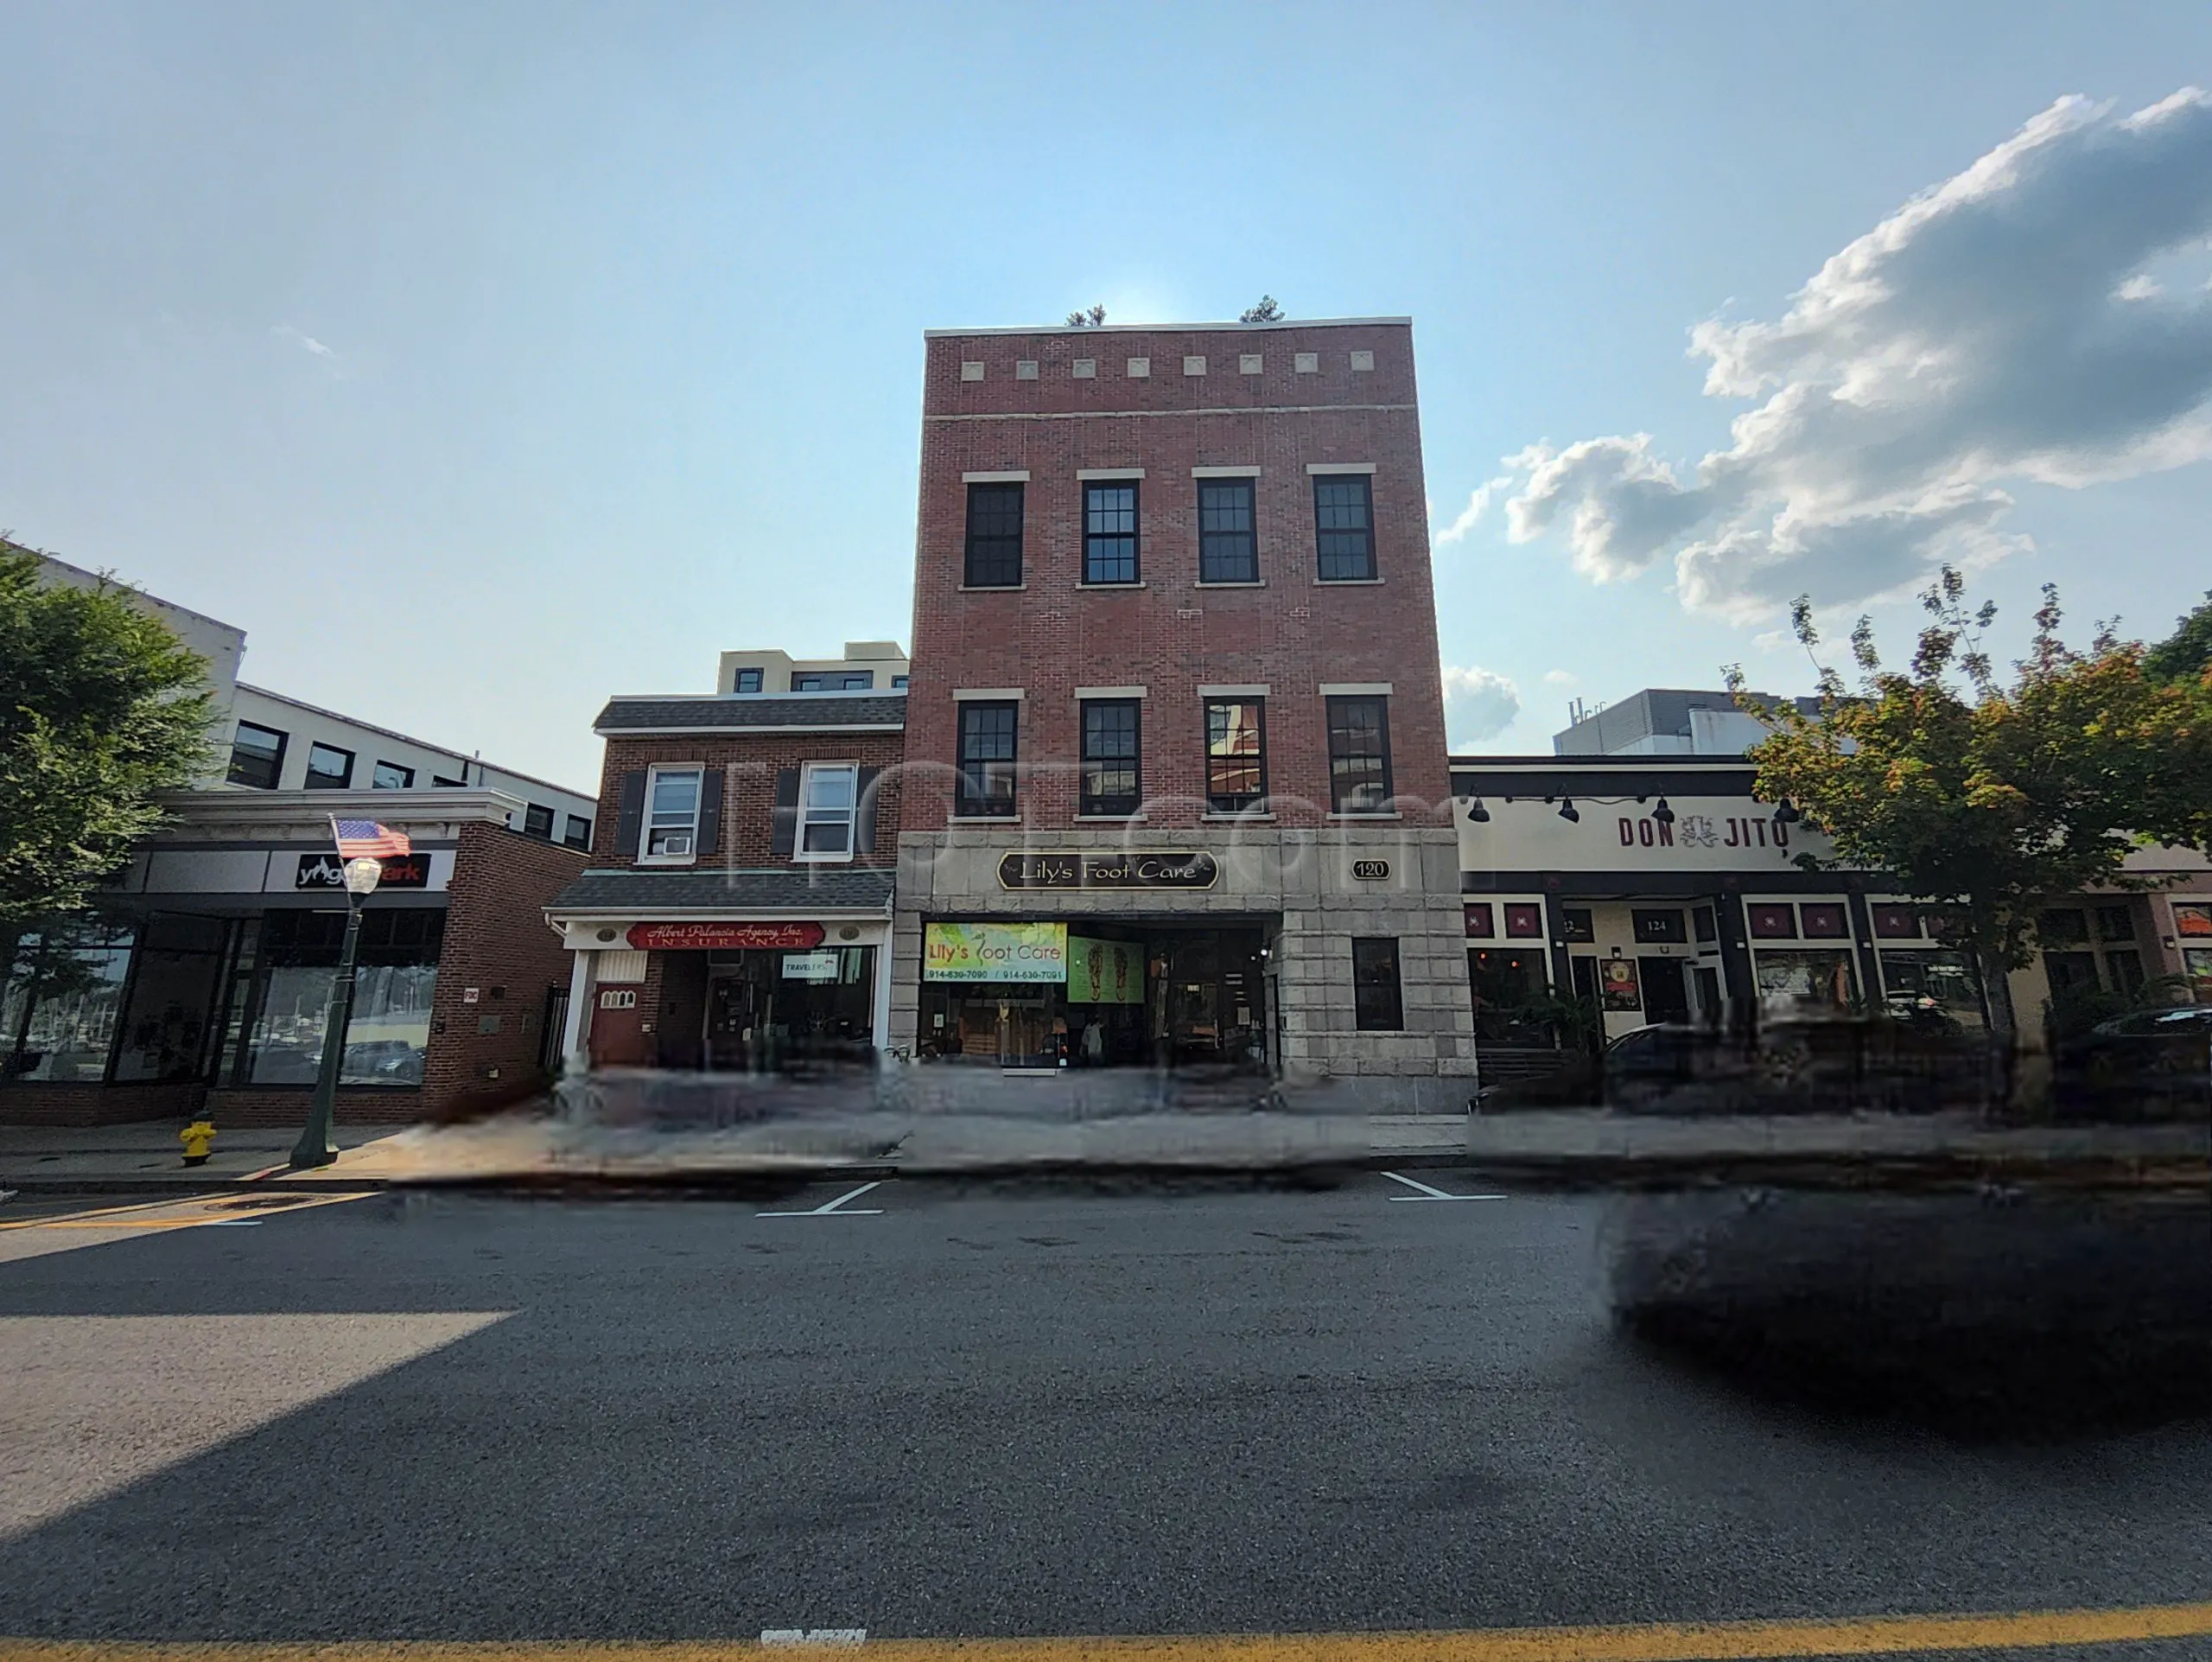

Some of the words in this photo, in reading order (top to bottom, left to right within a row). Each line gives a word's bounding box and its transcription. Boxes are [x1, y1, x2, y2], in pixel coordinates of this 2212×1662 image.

[1618, 818, 1674, 847] DON
[1724, 818, 1789, 847] JITO
[1020, 861, 1073, 884] Lily's
[1081, 861, 1130, 879] Foot
[1138, 861, 1197, 879] Care
[1357, 863, 1384, 876] 120
[647, 925, 685, 938] Albert
[781, 924, 804, 936] Inc.
[1648, 920, 1666, 931] 124
[929, 944, 969, 963] Lily's
[1017, 945, 1061, 960] Care
